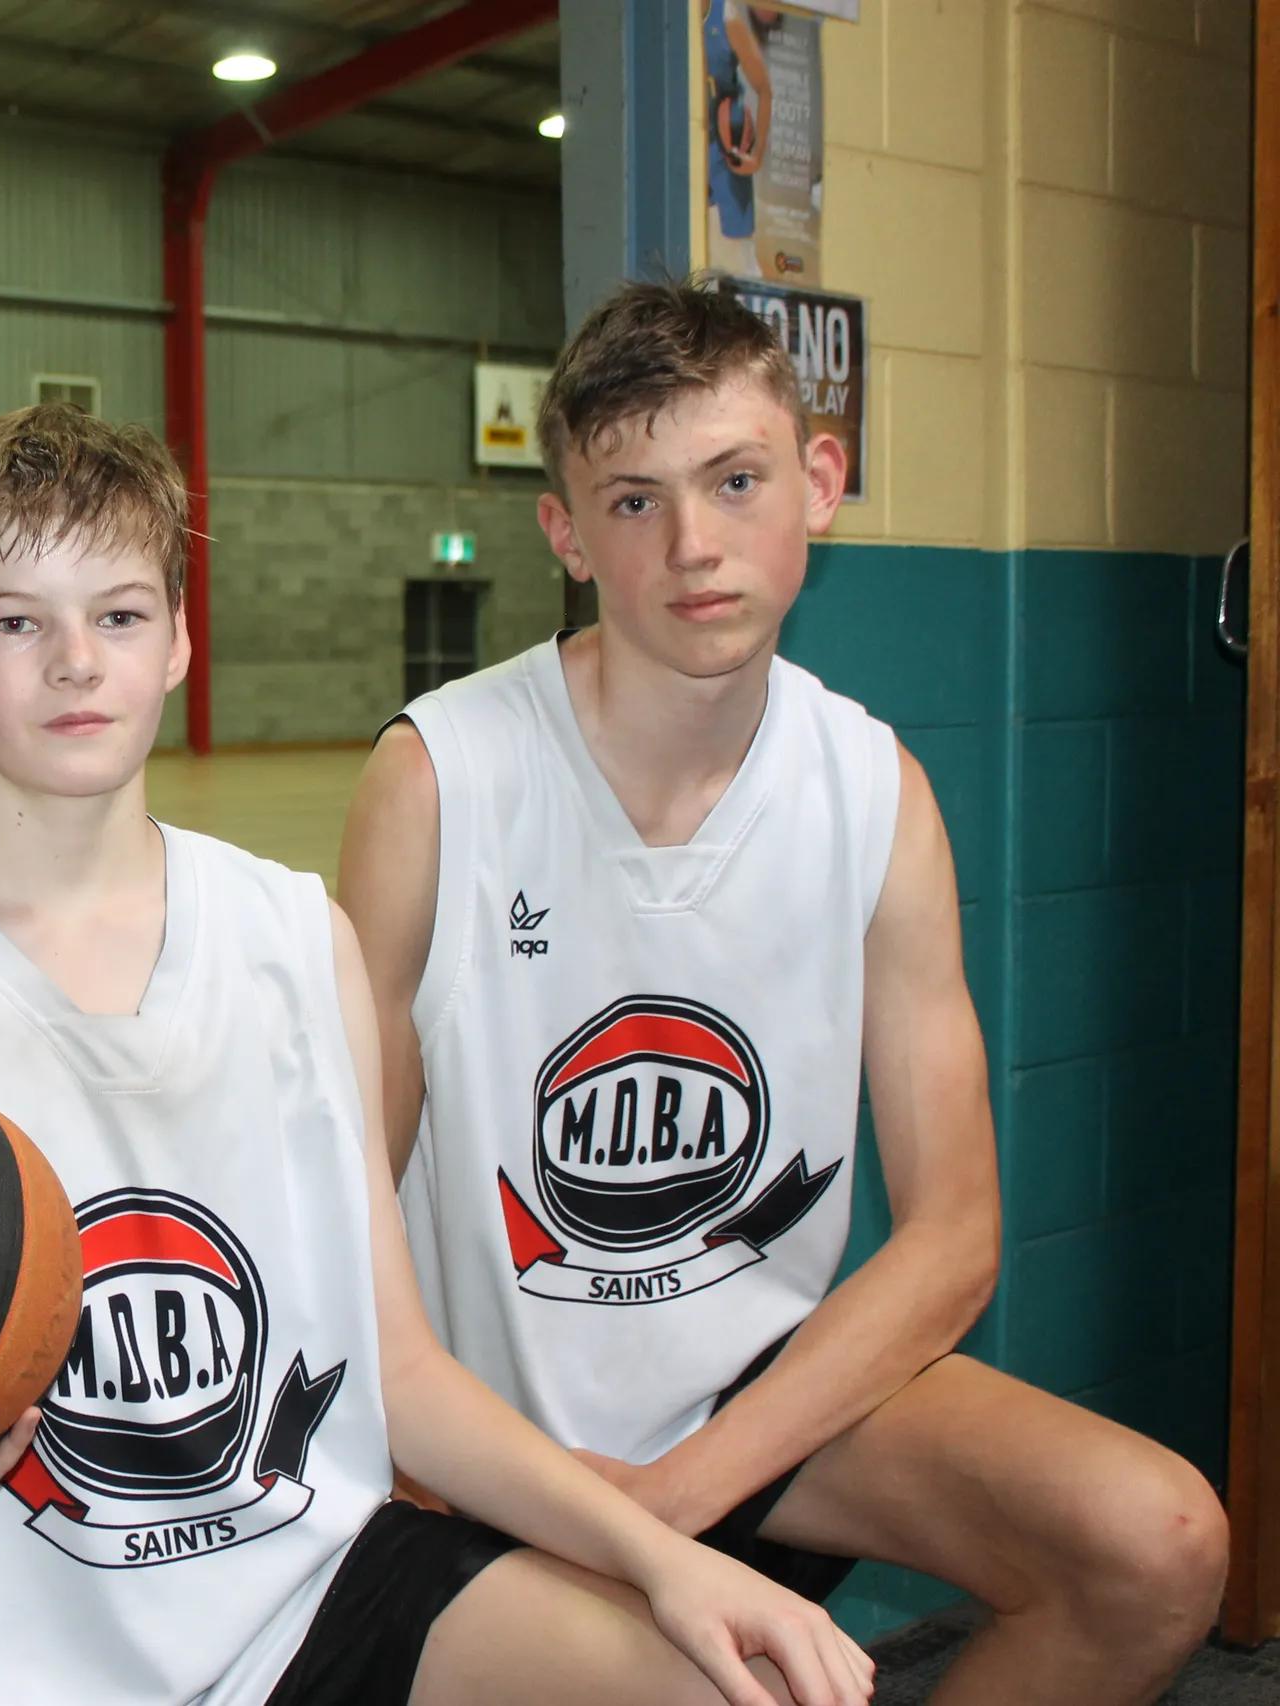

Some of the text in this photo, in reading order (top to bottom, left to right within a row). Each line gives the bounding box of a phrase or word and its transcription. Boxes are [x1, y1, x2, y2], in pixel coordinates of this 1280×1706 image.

[559, 1074, 726, 1167] M.D.B.A
[587, 1268, 682, 1301] SAINTS
[124, 1516, 238, 1563] SAINTS
